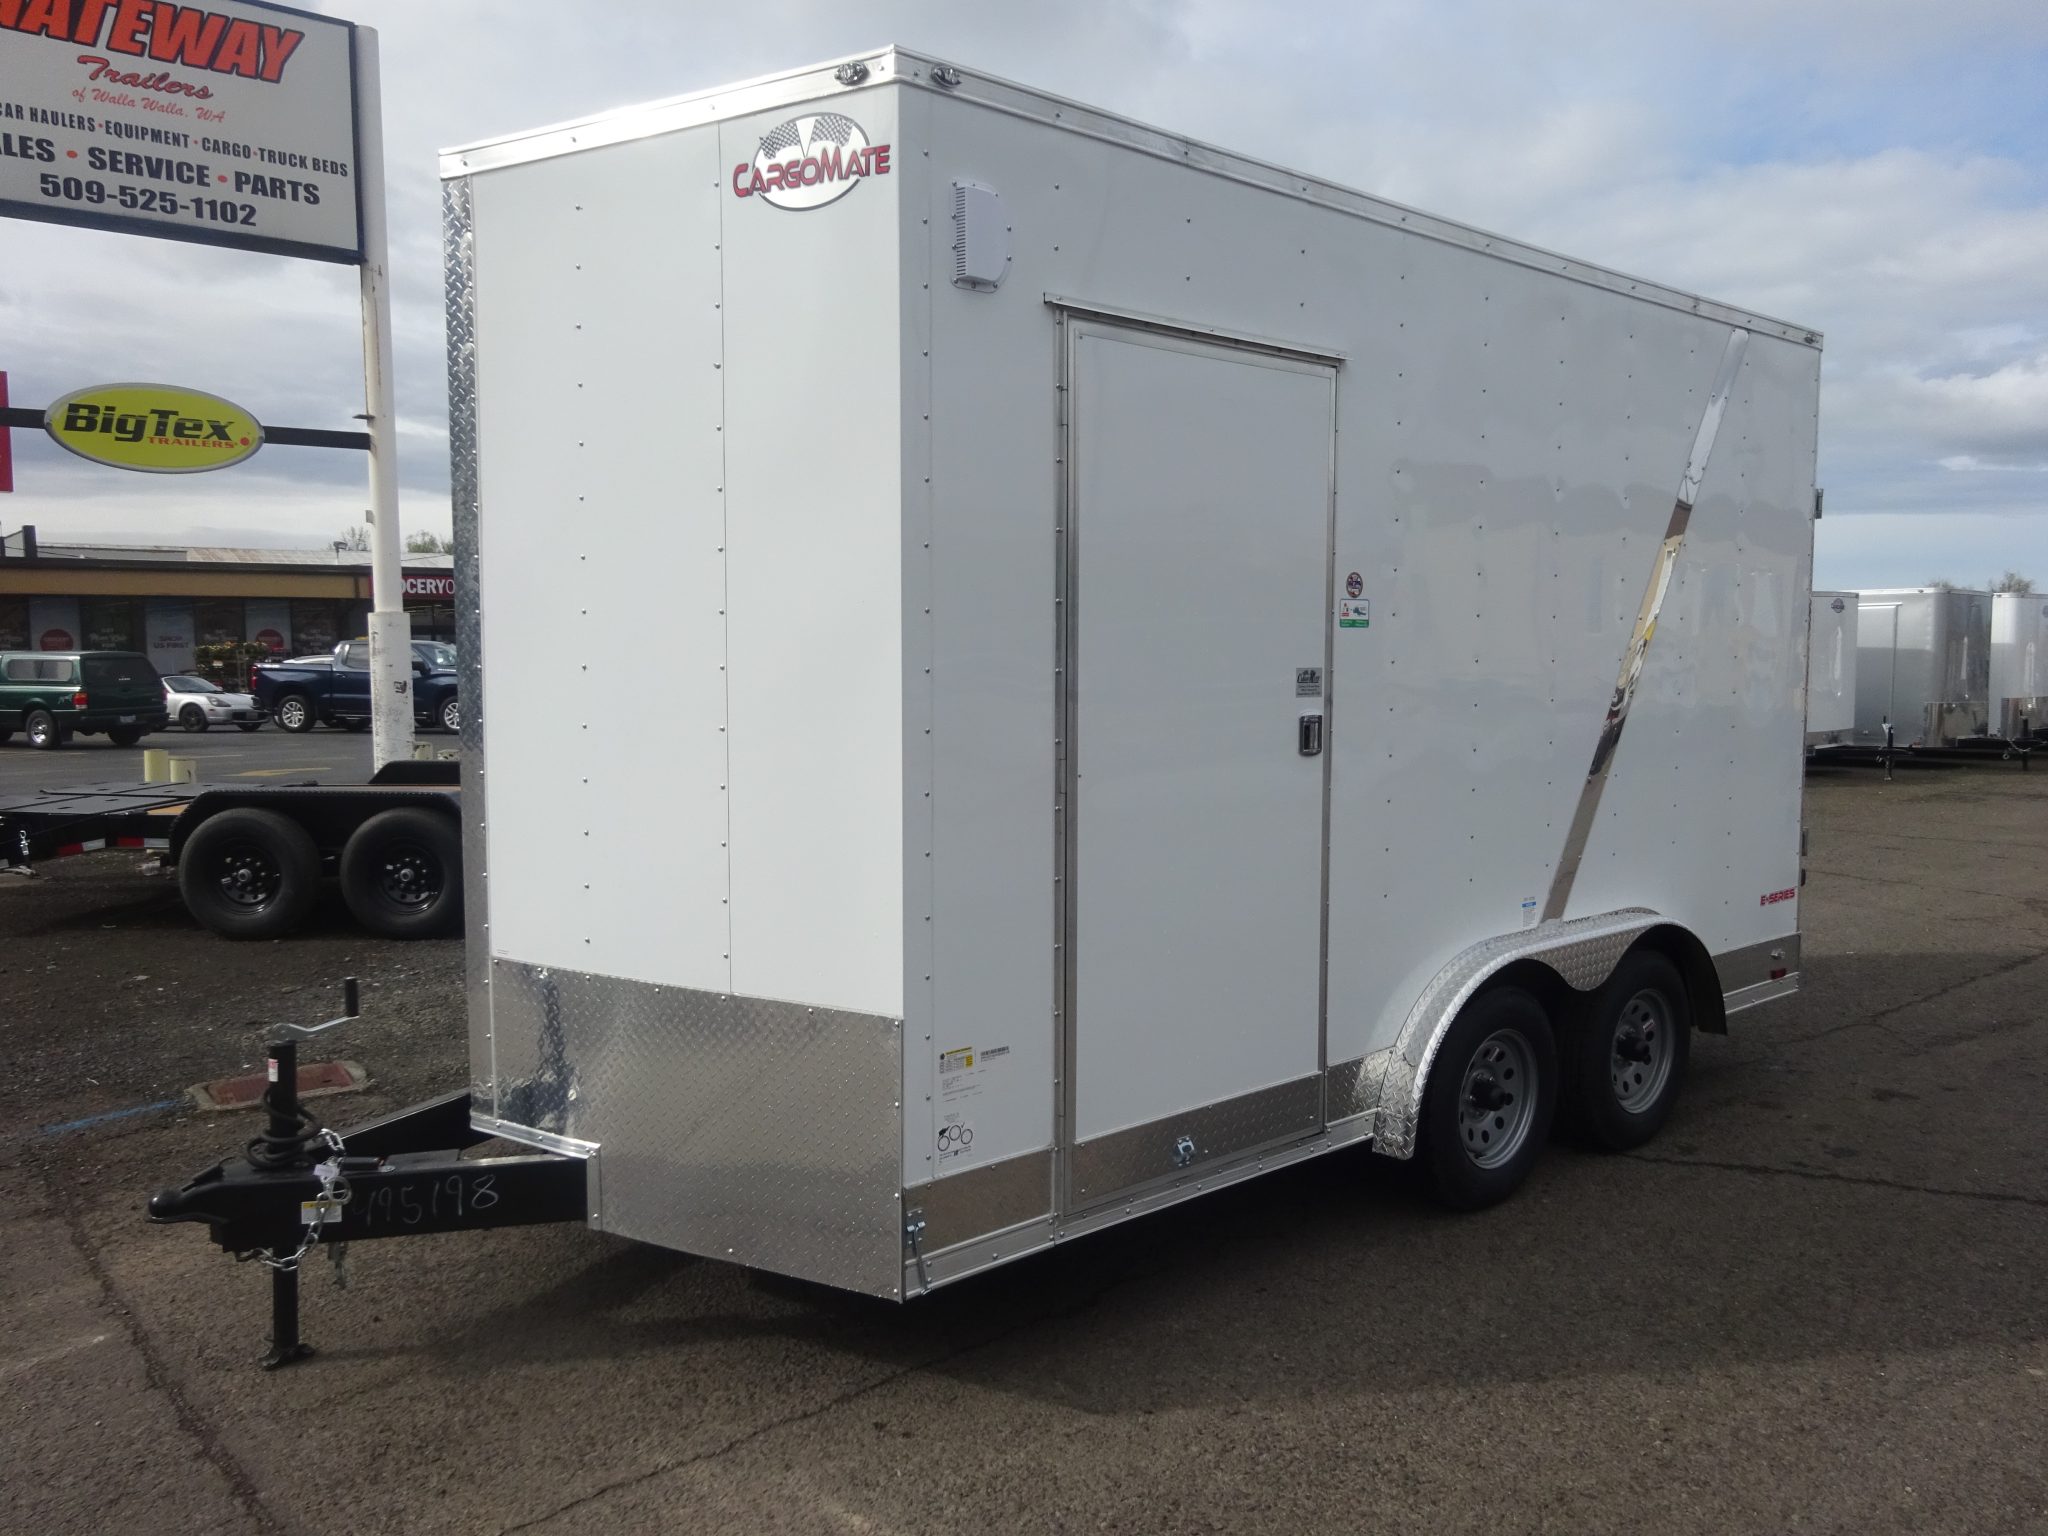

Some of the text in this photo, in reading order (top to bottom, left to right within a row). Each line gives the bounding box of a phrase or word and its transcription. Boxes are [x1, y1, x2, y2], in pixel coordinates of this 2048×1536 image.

[77, 55, 214, 100] Trailers
[72, 87, 87, 103] of
[91, 88, 136, 108] Walla
[195, 106, 226, 123] WA
[29, 106, 96, 133] HAULERS
[104, 119, 191, 149] EQUIPMENT
[201, 136, 251, 159] CARGO
[257, 147, 309, 170] TRUCK
[312, 157, 348, 177] BEDS
[40, 172, 257, 227] 509-525-1102
[87, 146, 211, 187] SERVICE
[234, 170, 320, 205] PARTS
[147, 436, 235, 449] TRAILERS
